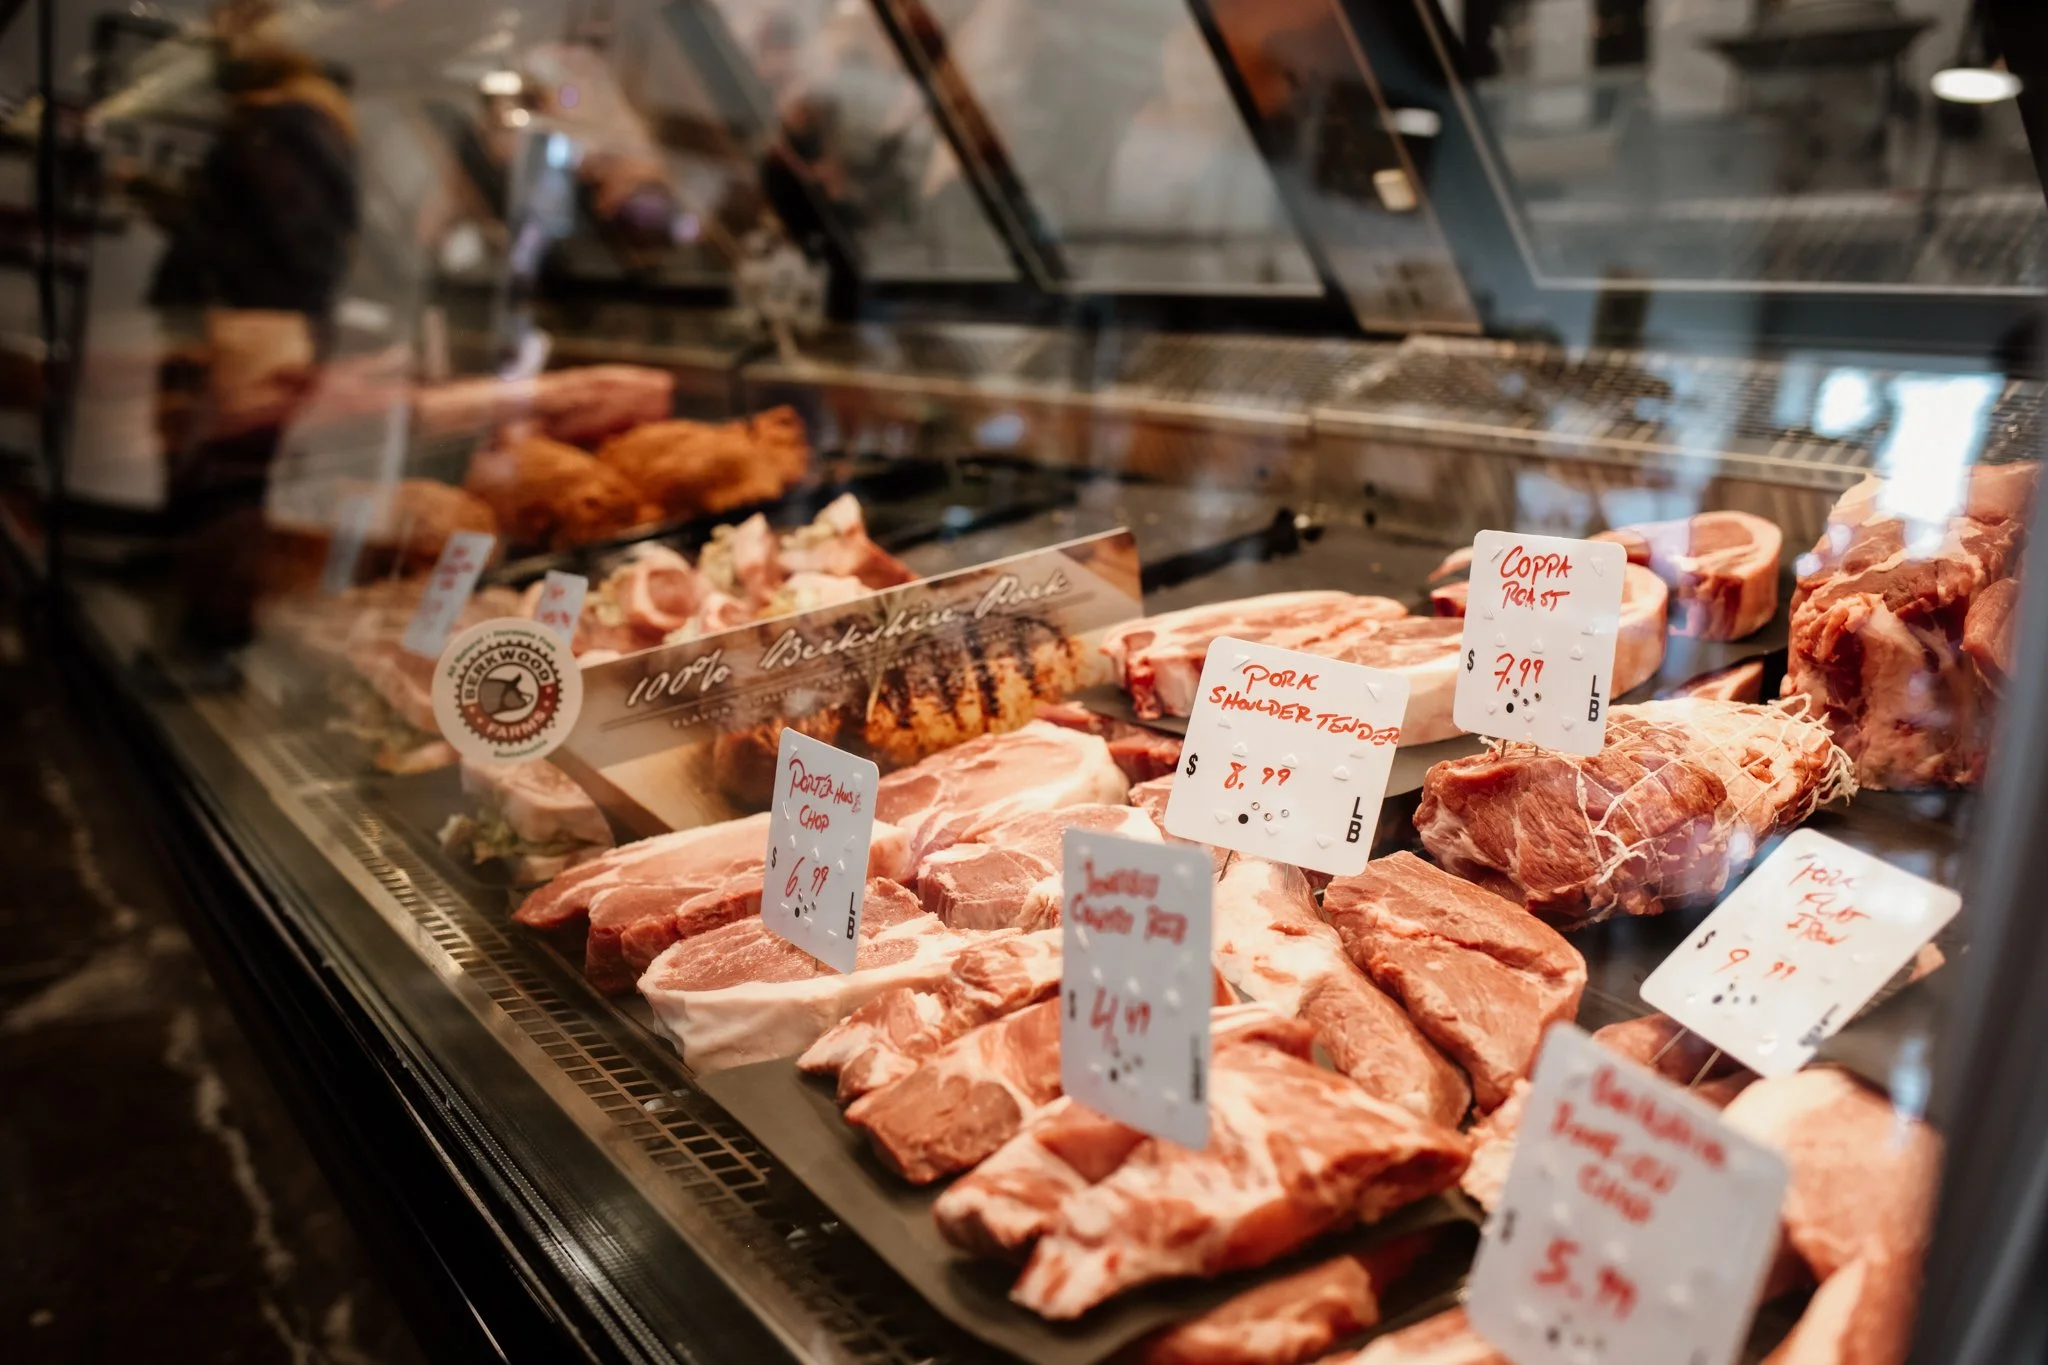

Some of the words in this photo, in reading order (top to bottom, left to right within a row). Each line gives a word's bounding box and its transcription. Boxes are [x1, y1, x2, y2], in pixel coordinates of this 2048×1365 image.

[1500, 545, 1572, 585] COPPA
[1502, 580, 1571, 611] ROAST
[627, 648, 731, 706] 100%
[758, 600, 955, 670] Berkshire
[974, 568, 1073, 620] Pork
[464, 649, 551, 701] BERKWOOD
[1242, 664, 1320, 693] PORK
[1467, 648, 1475, 674] $
[1494, 653, 1545, 691] 7.99
[486, 710, 547, 739] FARMS
[1208, 686, 1313, 724] SHOULDER
[1316, 713, 1401, 746] TENDER
[1186, 753, 1198, 778] $
[799, 804, 830, 833] CHOP
[785, 857, 829, 897] 6.99
